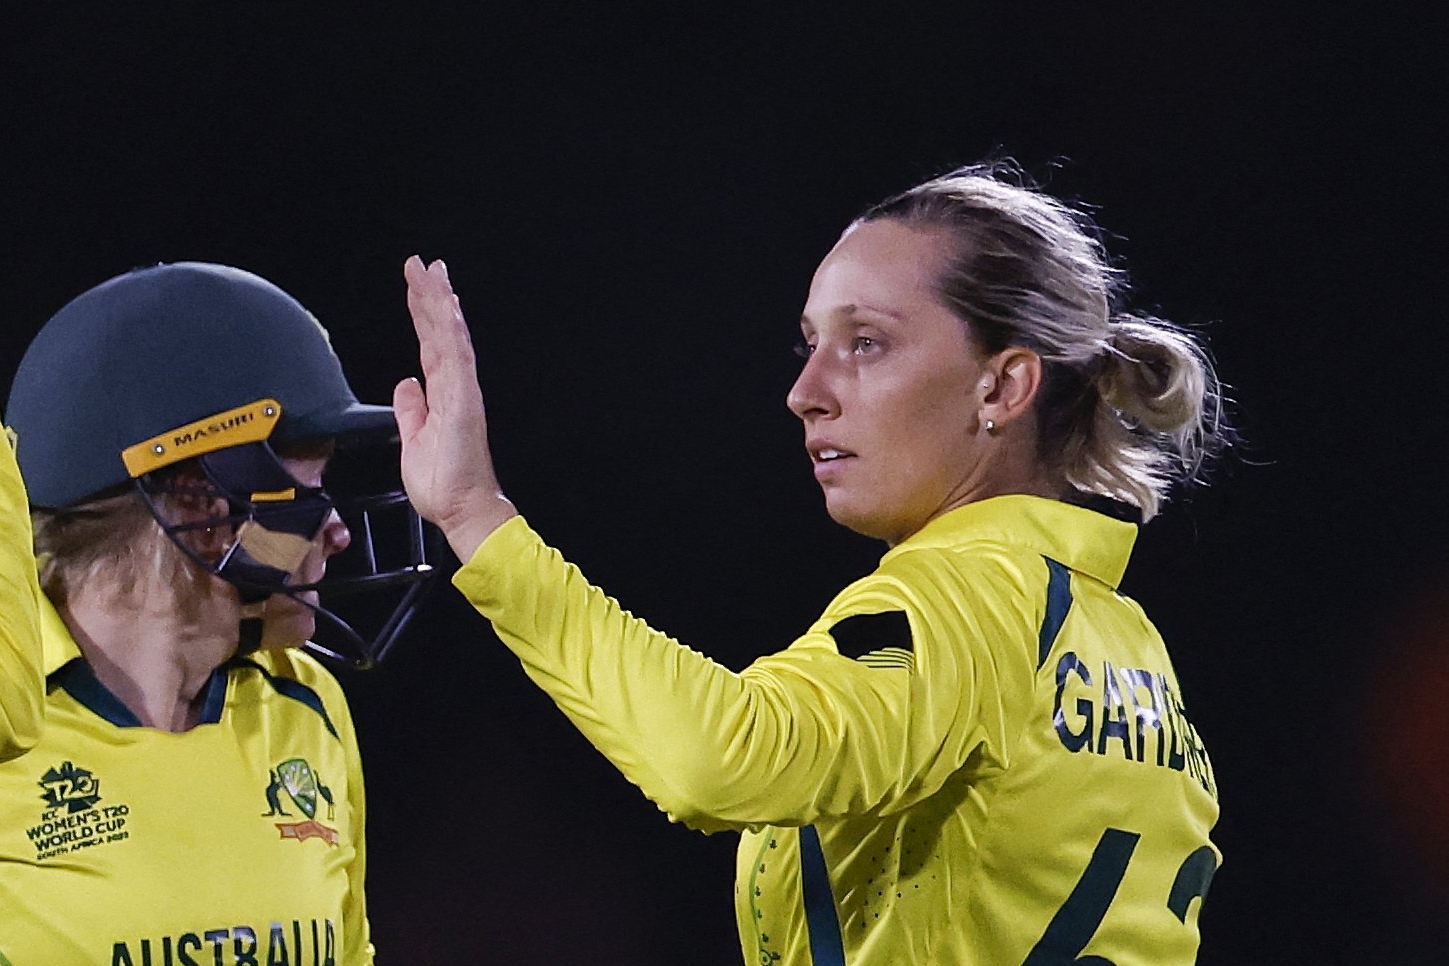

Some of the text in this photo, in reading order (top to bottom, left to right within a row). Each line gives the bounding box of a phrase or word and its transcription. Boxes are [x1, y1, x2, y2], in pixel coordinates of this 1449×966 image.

[174, 412, 254, 448] MASURI
[44, 775, 97, 802] T20
[26, 805, 129, 840] WOMEN'S T20
[35, 818, 125, 851] WORLD CUP
